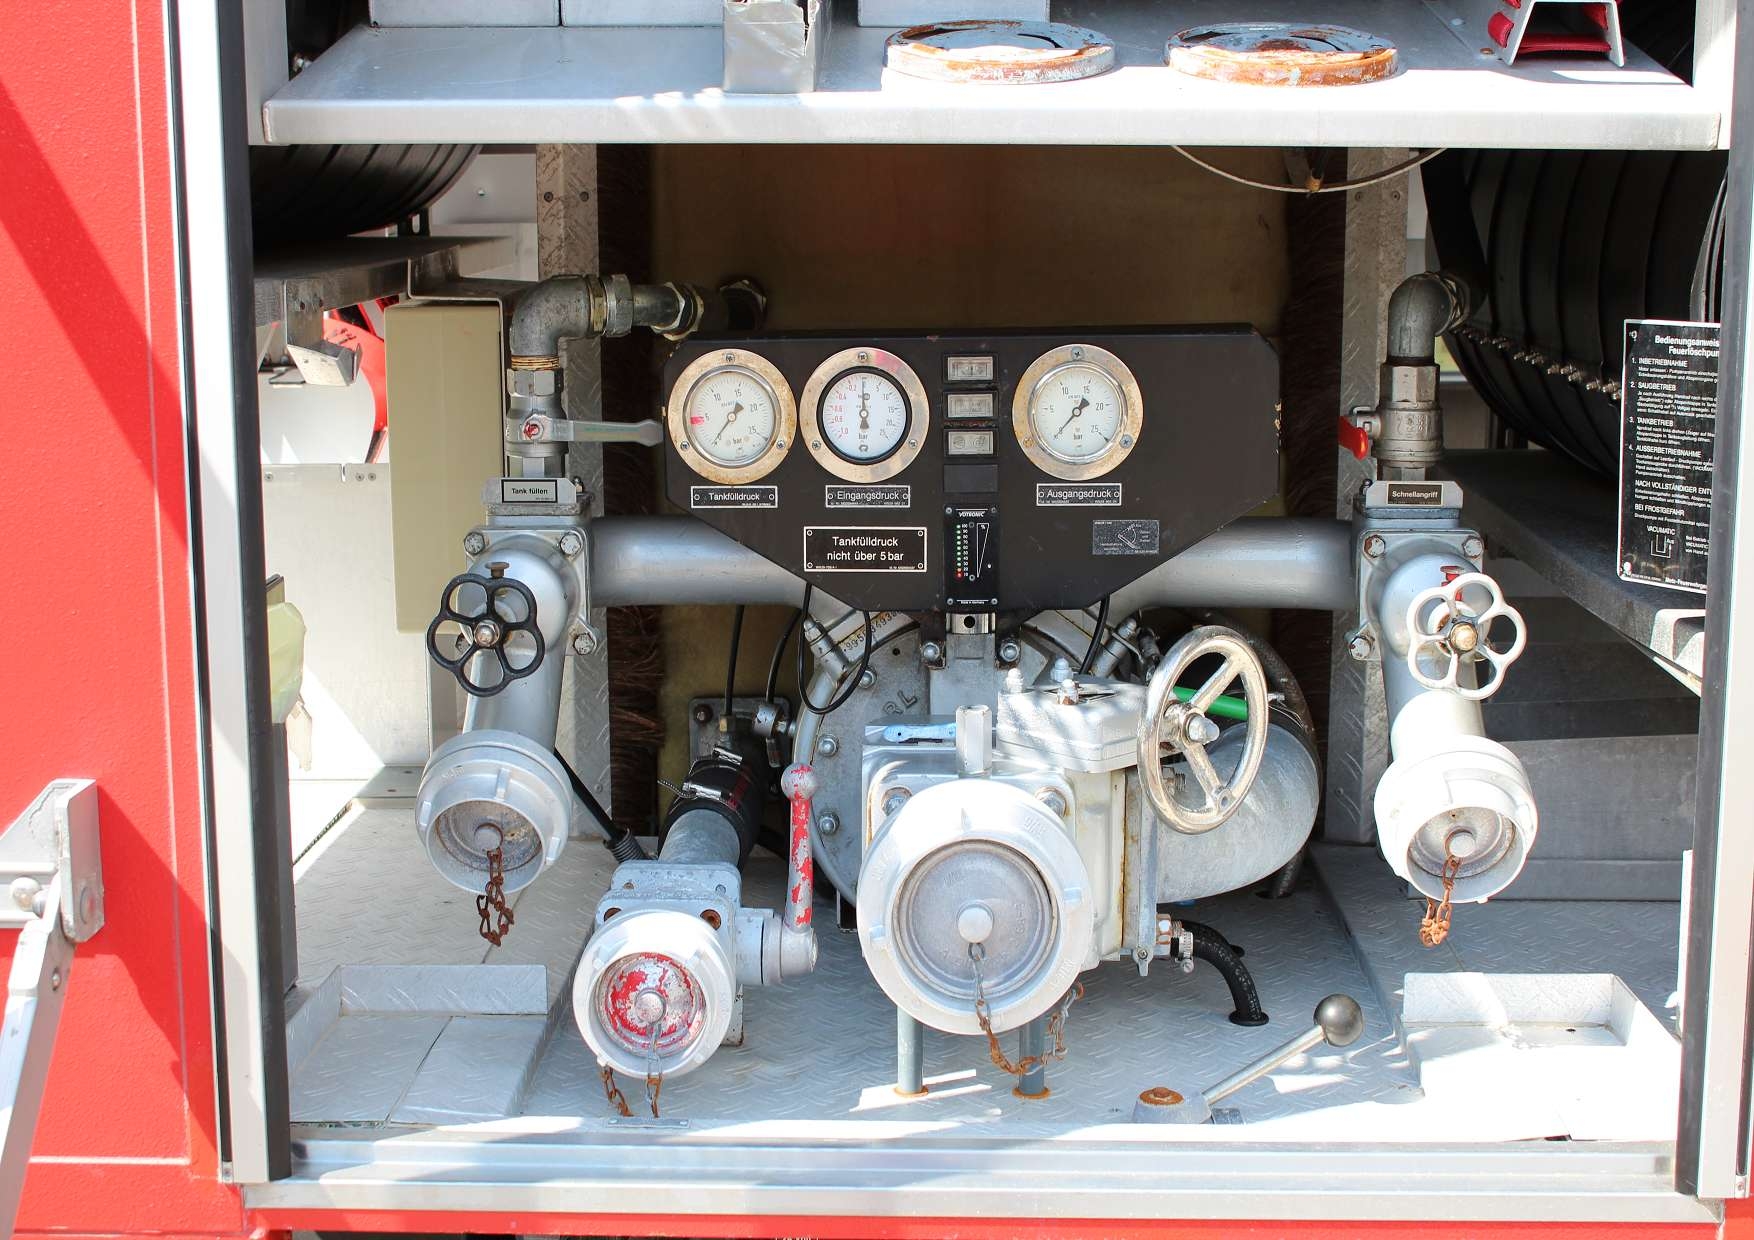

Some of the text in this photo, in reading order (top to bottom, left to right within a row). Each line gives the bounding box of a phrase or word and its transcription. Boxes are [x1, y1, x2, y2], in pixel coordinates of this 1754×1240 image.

[1638, 358, 1688, 368] INBETRIEBNAHME
[1062, 386, 1068, 395] 10
[1084, 386, 1090, 394] 15
[1638, 382, 1677, 392] SAUGBETRIEB
[734, 389, 742, 398] 15
[750, 403, 758, 412] 20
[1096, 402, 1104, 411] 20
[1637, 417, 1674, 427] TANKBETRIEB
[1091, 425, 1098, 433] 25
[1636, 445, 1701, 458] AUSSERBETRIEBNAHME
[1635, 480, 1651, 488] NACH
[1652, 481, 1697, 493] VOLLSTÄNDIGER
[709, 492, 760, 501] Tankfülldruck
[837, 491, 900, 502] Eingangsdruck
[1046, 490, 1112, 500] Ausgangsdruck
[1392, 490, 1438, 500] Schnellangriff
[1645, 505, 1684, 516] FROSTGEFAHR
[1647, 525, 1675, 535] VACUMATIC
[832, 536, 898, 546] Tankfülldruck
[827, 551, 904, 561] nicht über 5 bar
